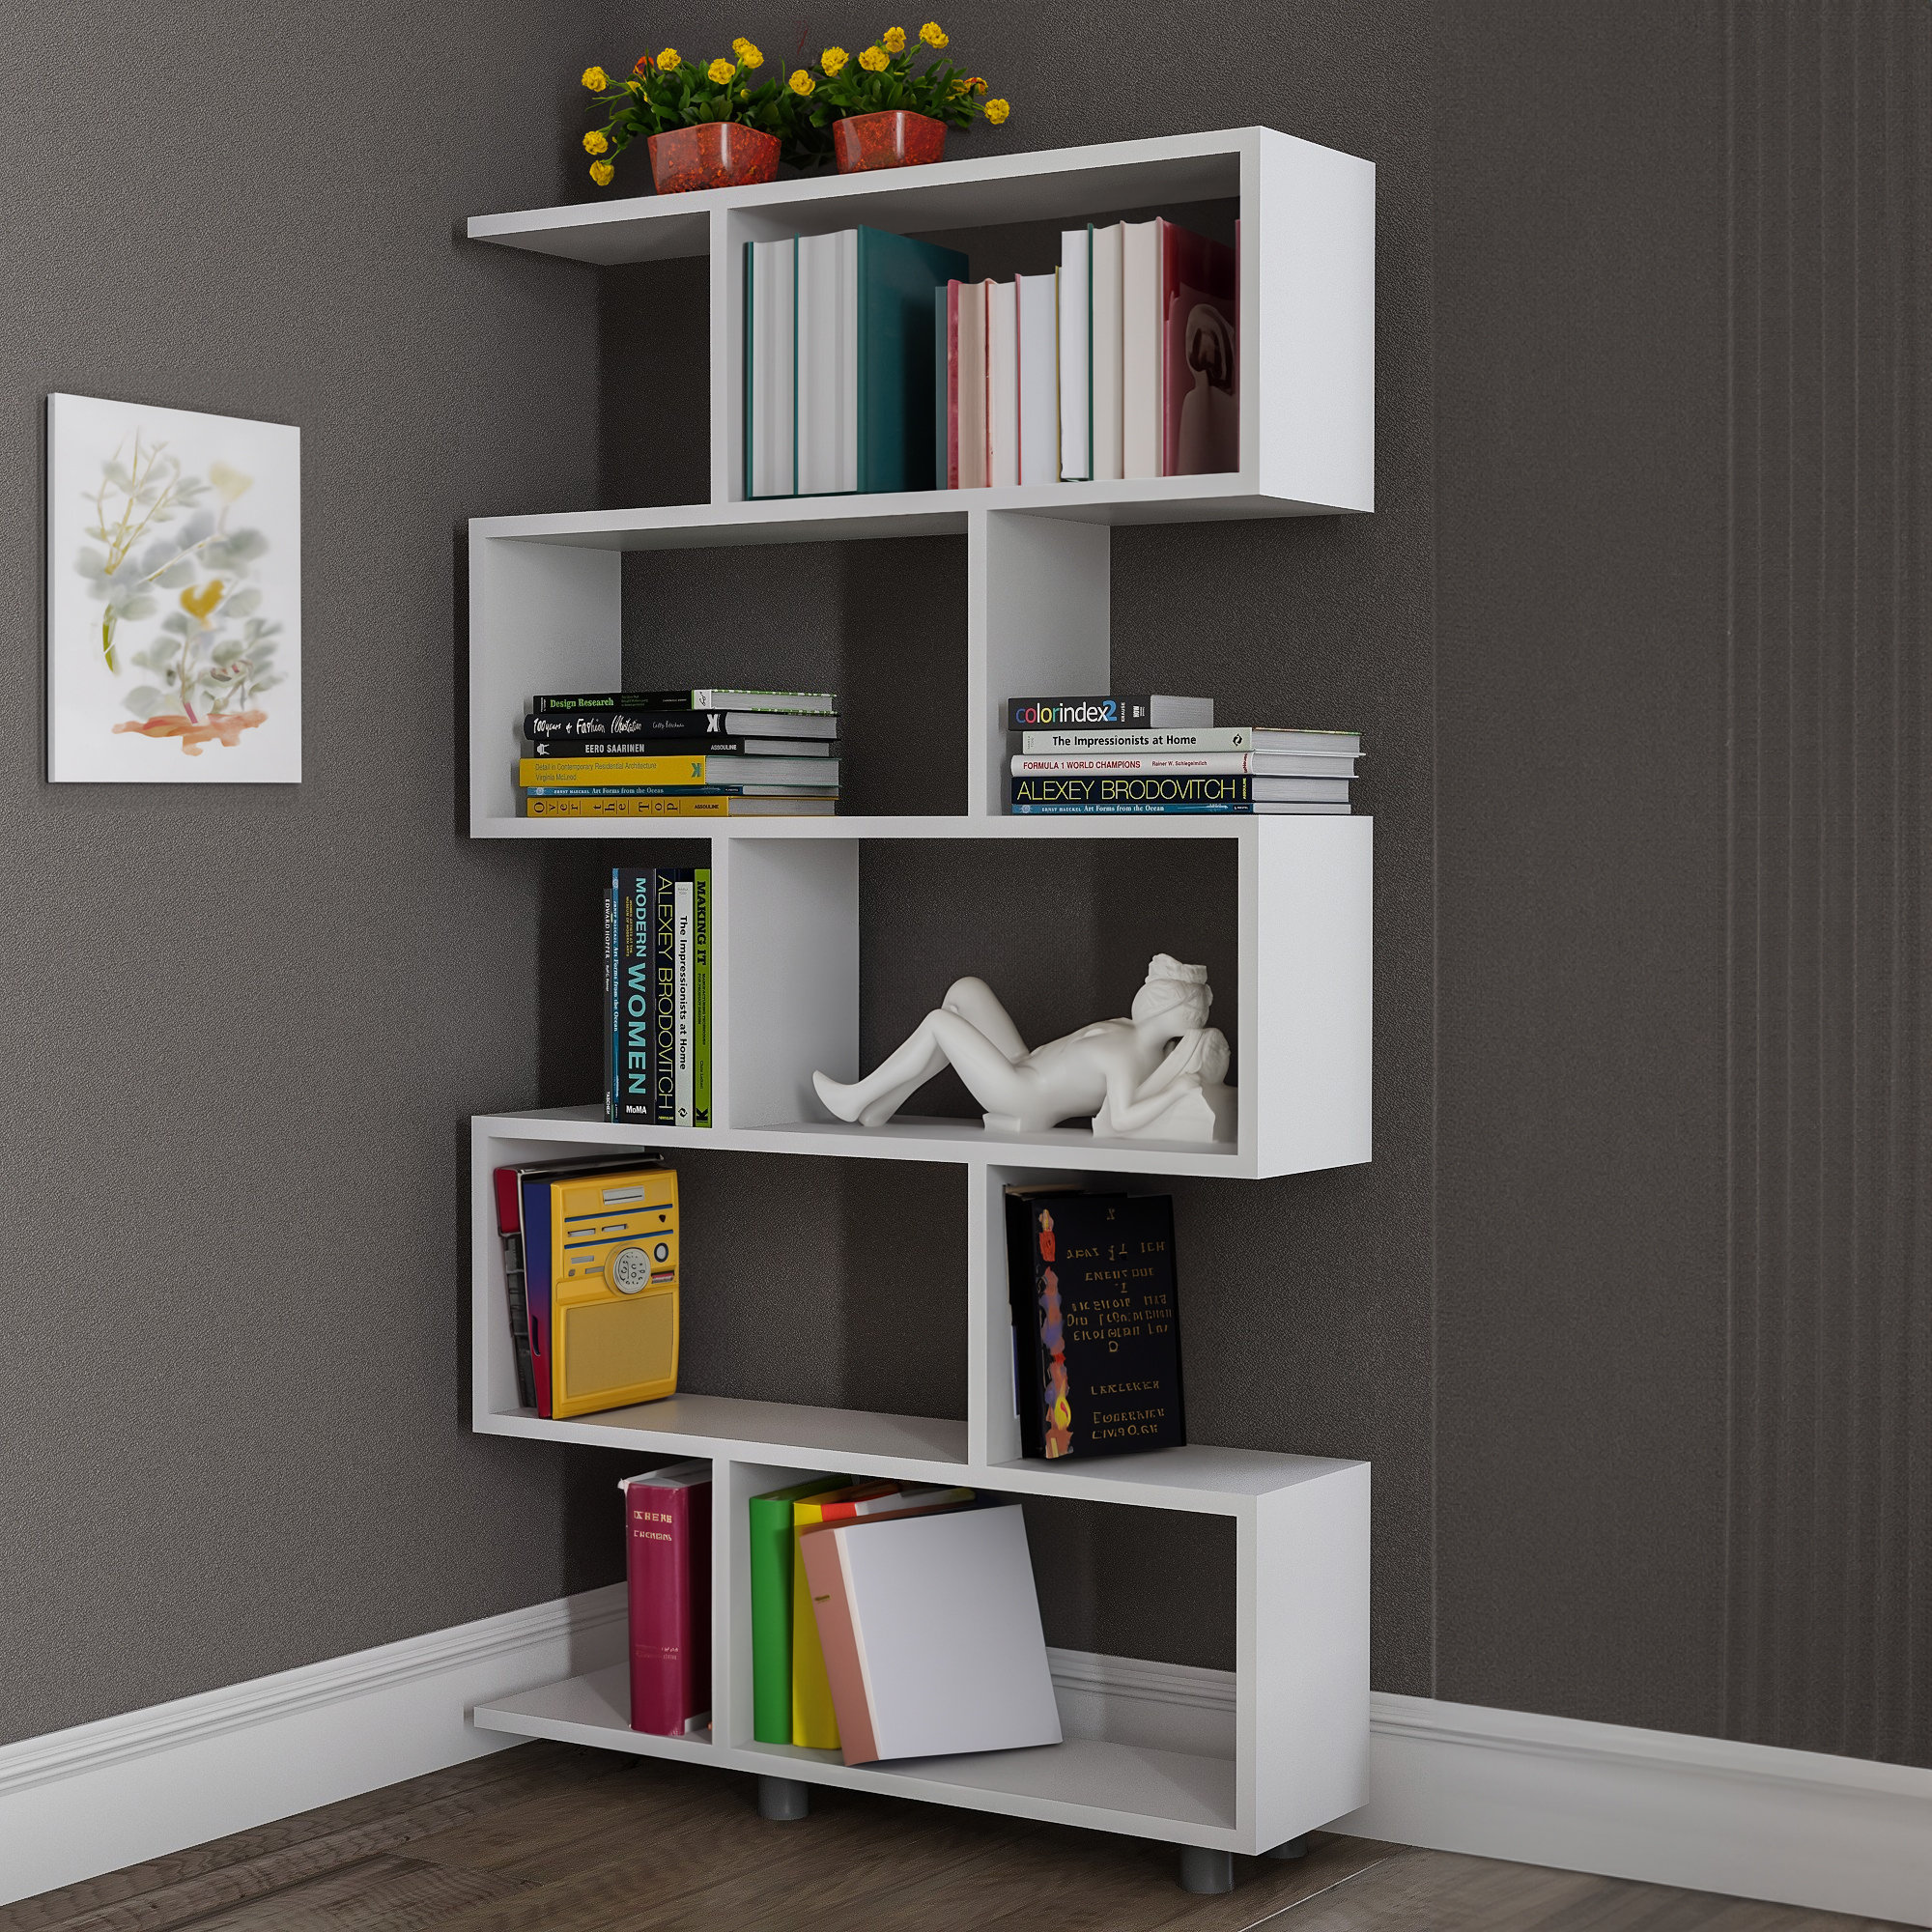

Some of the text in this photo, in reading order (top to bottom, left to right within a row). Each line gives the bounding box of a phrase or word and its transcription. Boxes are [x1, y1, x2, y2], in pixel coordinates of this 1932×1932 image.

[550, 698, 577, 710] Design
[578, 696, 614, 707] Research
[584, 743, 645, 753] EERO SAARINEN
[1052, 734, 1197, 748] The Impressionists at Home
[556, 762, 594, 772] Contemporary
[625, 761, 658, 770] Architecture
[1023, 761, 1060, 770] FORMULA
[1066, 760, 1094, 769] WORLD
[1095, 760, 1141, 769] CHAMPIONS
[535, 774, 554, 782] Virginia
[1016, 779, 1236, 801] ALEXEY BRODOVITCH
[592, 802, 627, 813] the
[638, 801, 678, 813] Top
[696, 880, 707, 966] MAKING IT
[627, 877, 647, 1094] MODERN WOMEN
[658, 874, 674, 1109] ALEXEY BRODOVITCH
[678, 915, 689, 1070] The Impressionists at Home
[625, 1104, 647, 1115] MoMA
